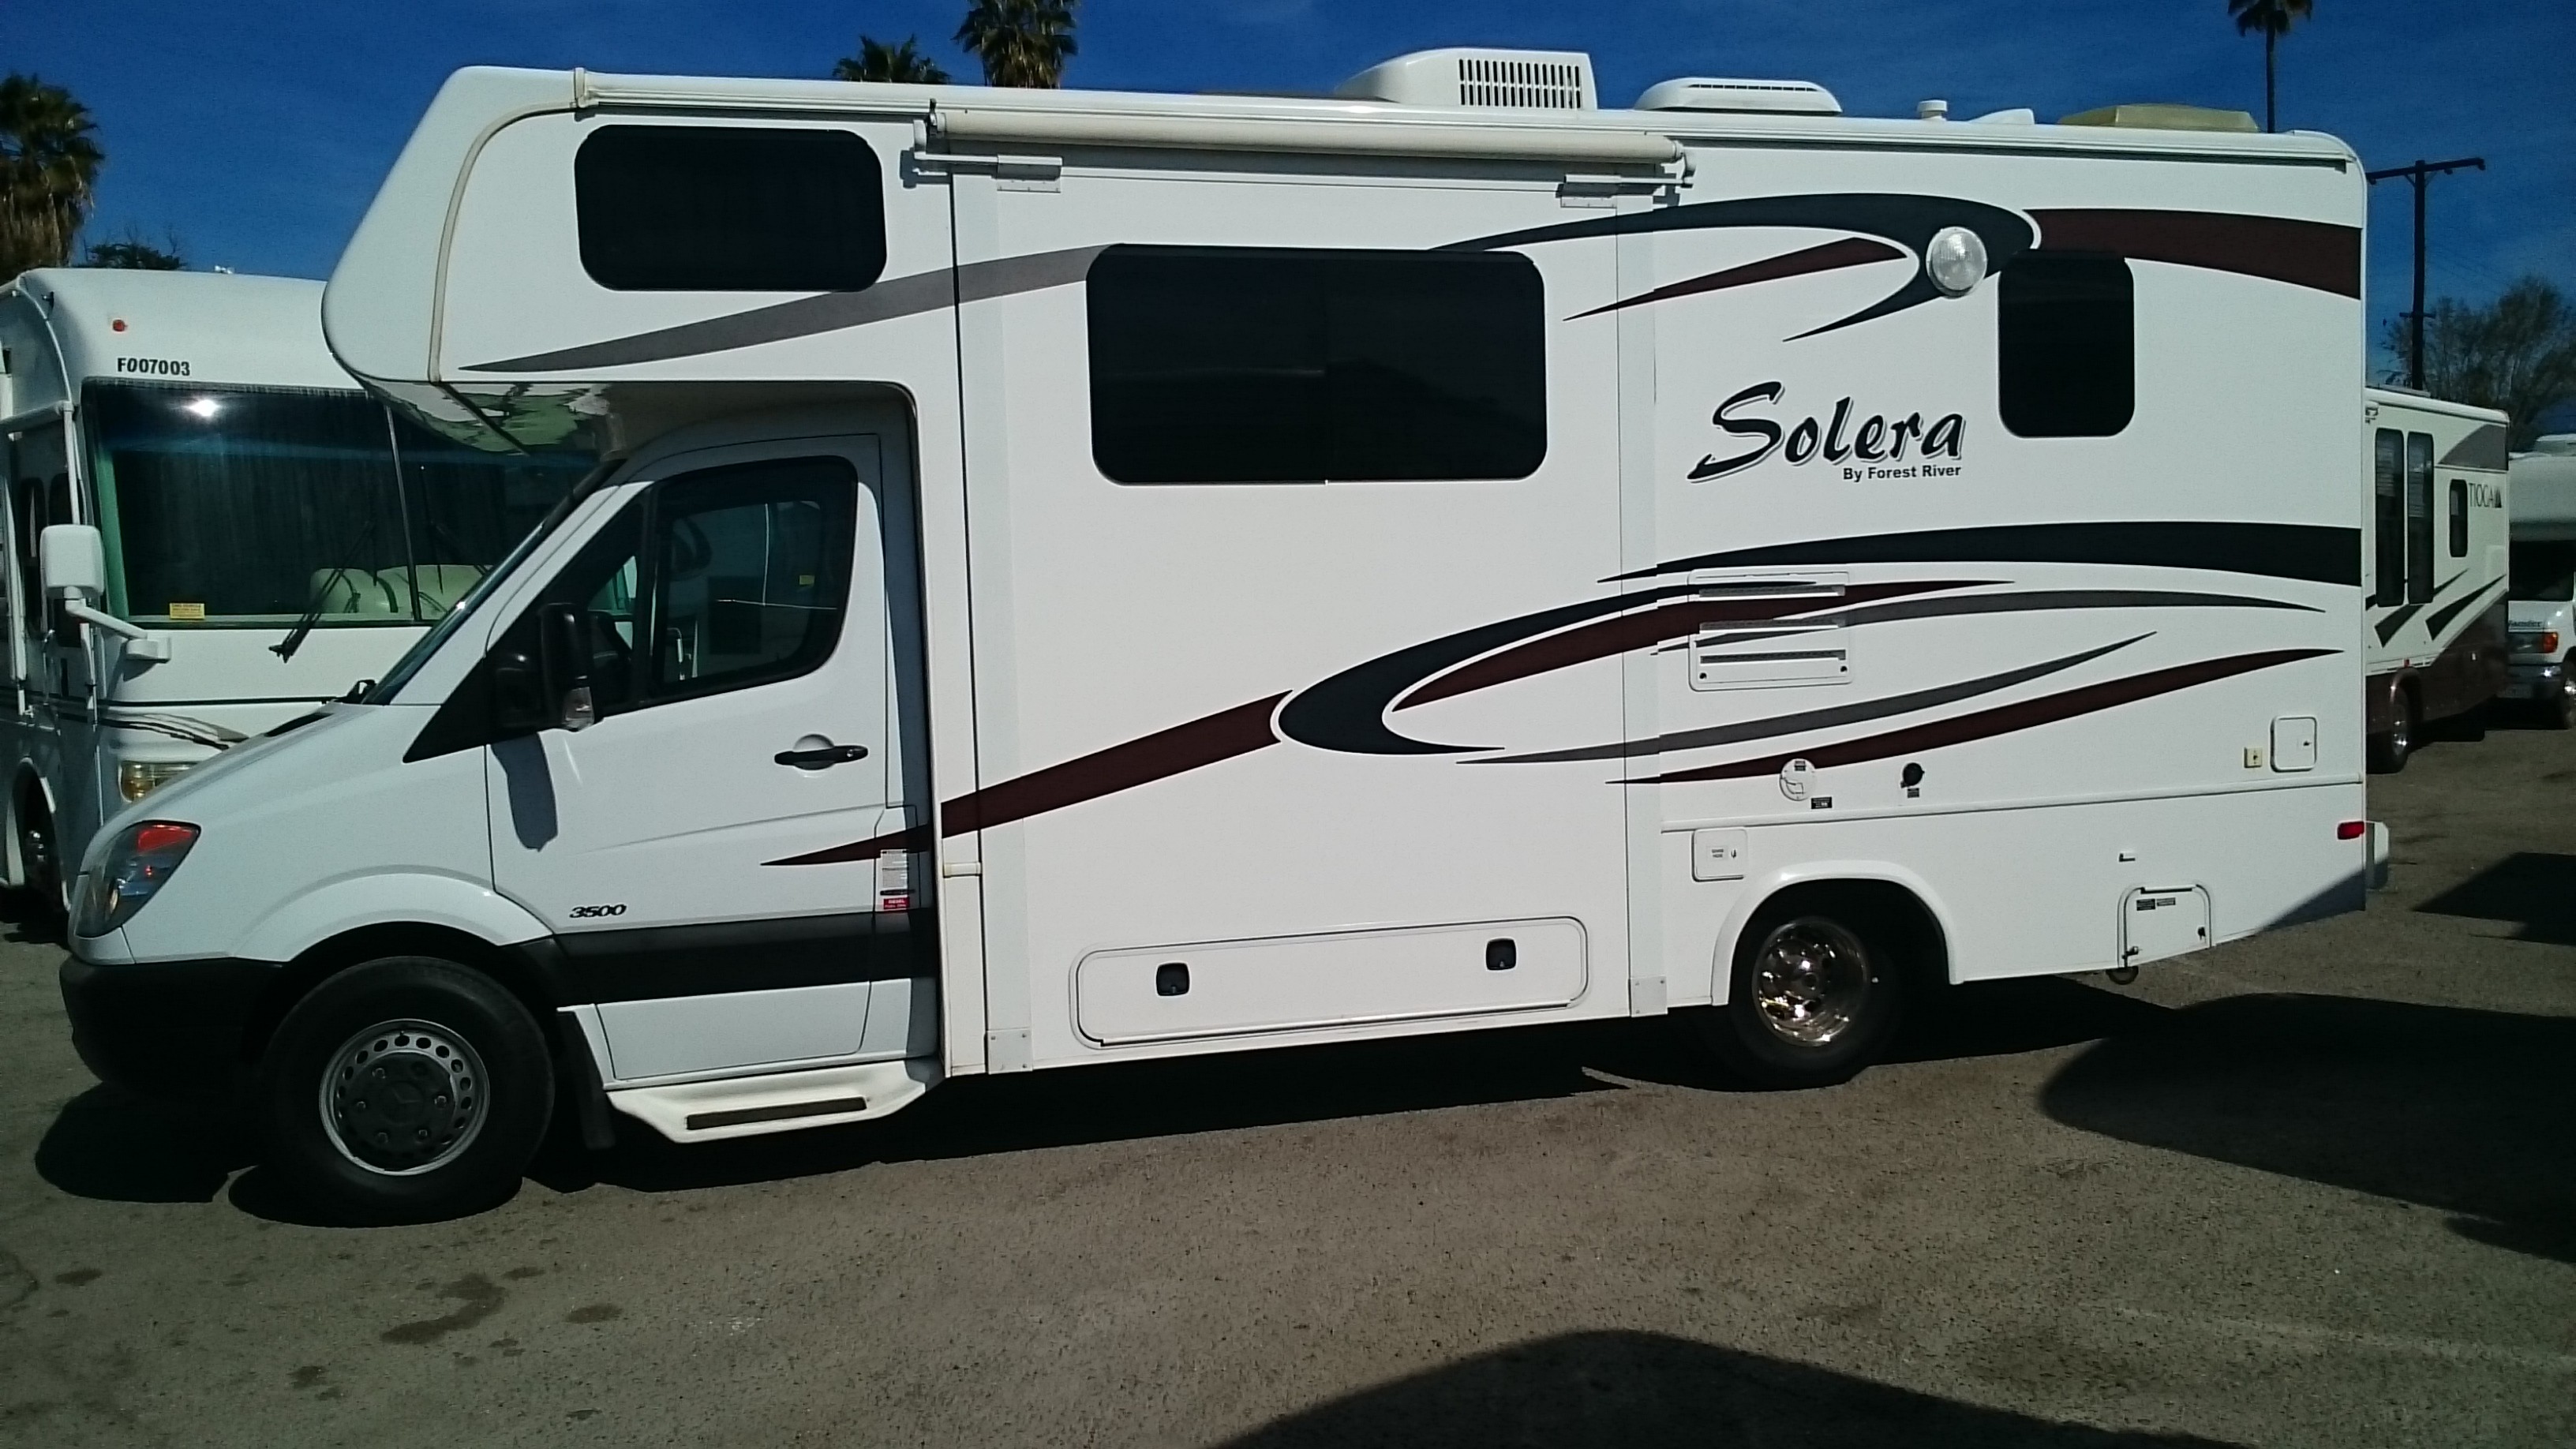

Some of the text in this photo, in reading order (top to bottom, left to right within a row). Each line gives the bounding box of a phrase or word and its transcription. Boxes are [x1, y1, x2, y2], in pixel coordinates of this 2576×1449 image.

[117, 358, 190, 376] F007003
[1687, 381, 1966, 484] Solera
[1843, 464, 1961, 483] By Forest River
[569, 904, 627, 918] 3500
